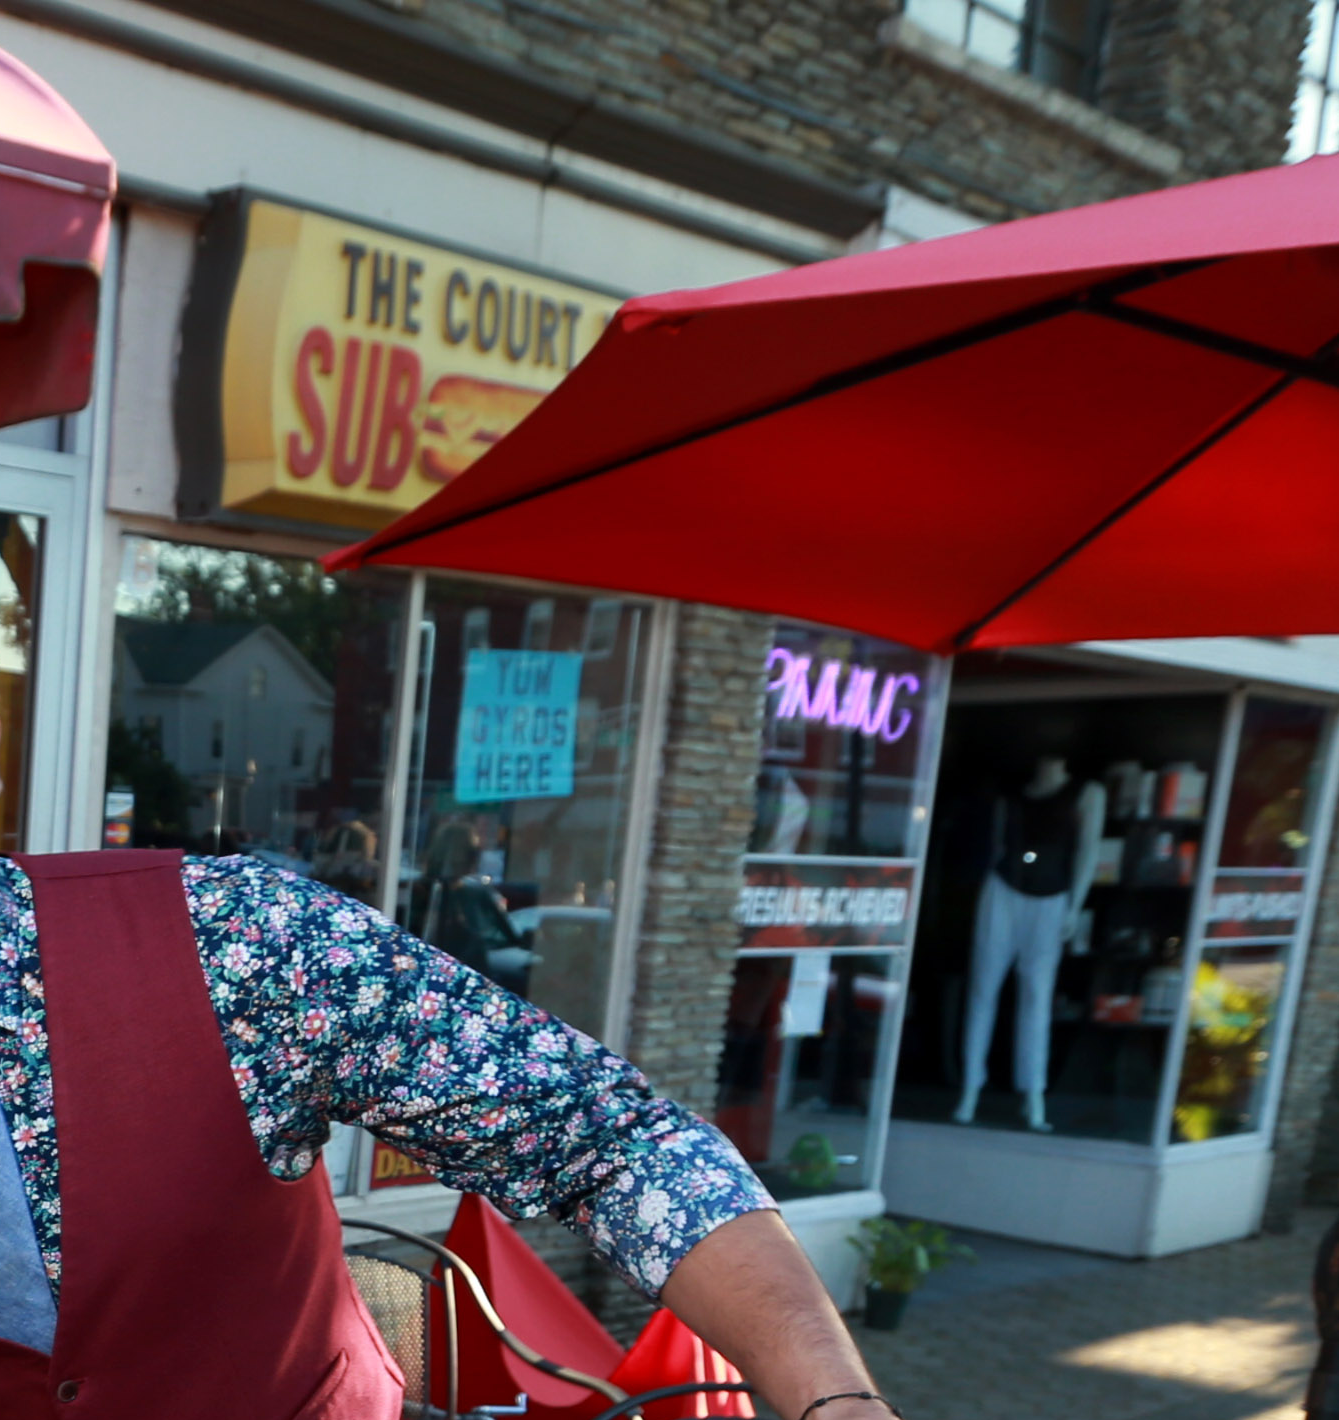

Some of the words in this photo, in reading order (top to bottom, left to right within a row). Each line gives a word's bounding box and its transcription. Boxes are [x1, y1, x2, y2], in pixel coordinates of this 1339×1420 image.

[342, 241, 424, 335] THE
[441, 267, 583, 371] COURT
[286, 324, 422, 492] SUB
[472, 704, 569, 747] GYROS
[475, 752, 554, 793] HERE
